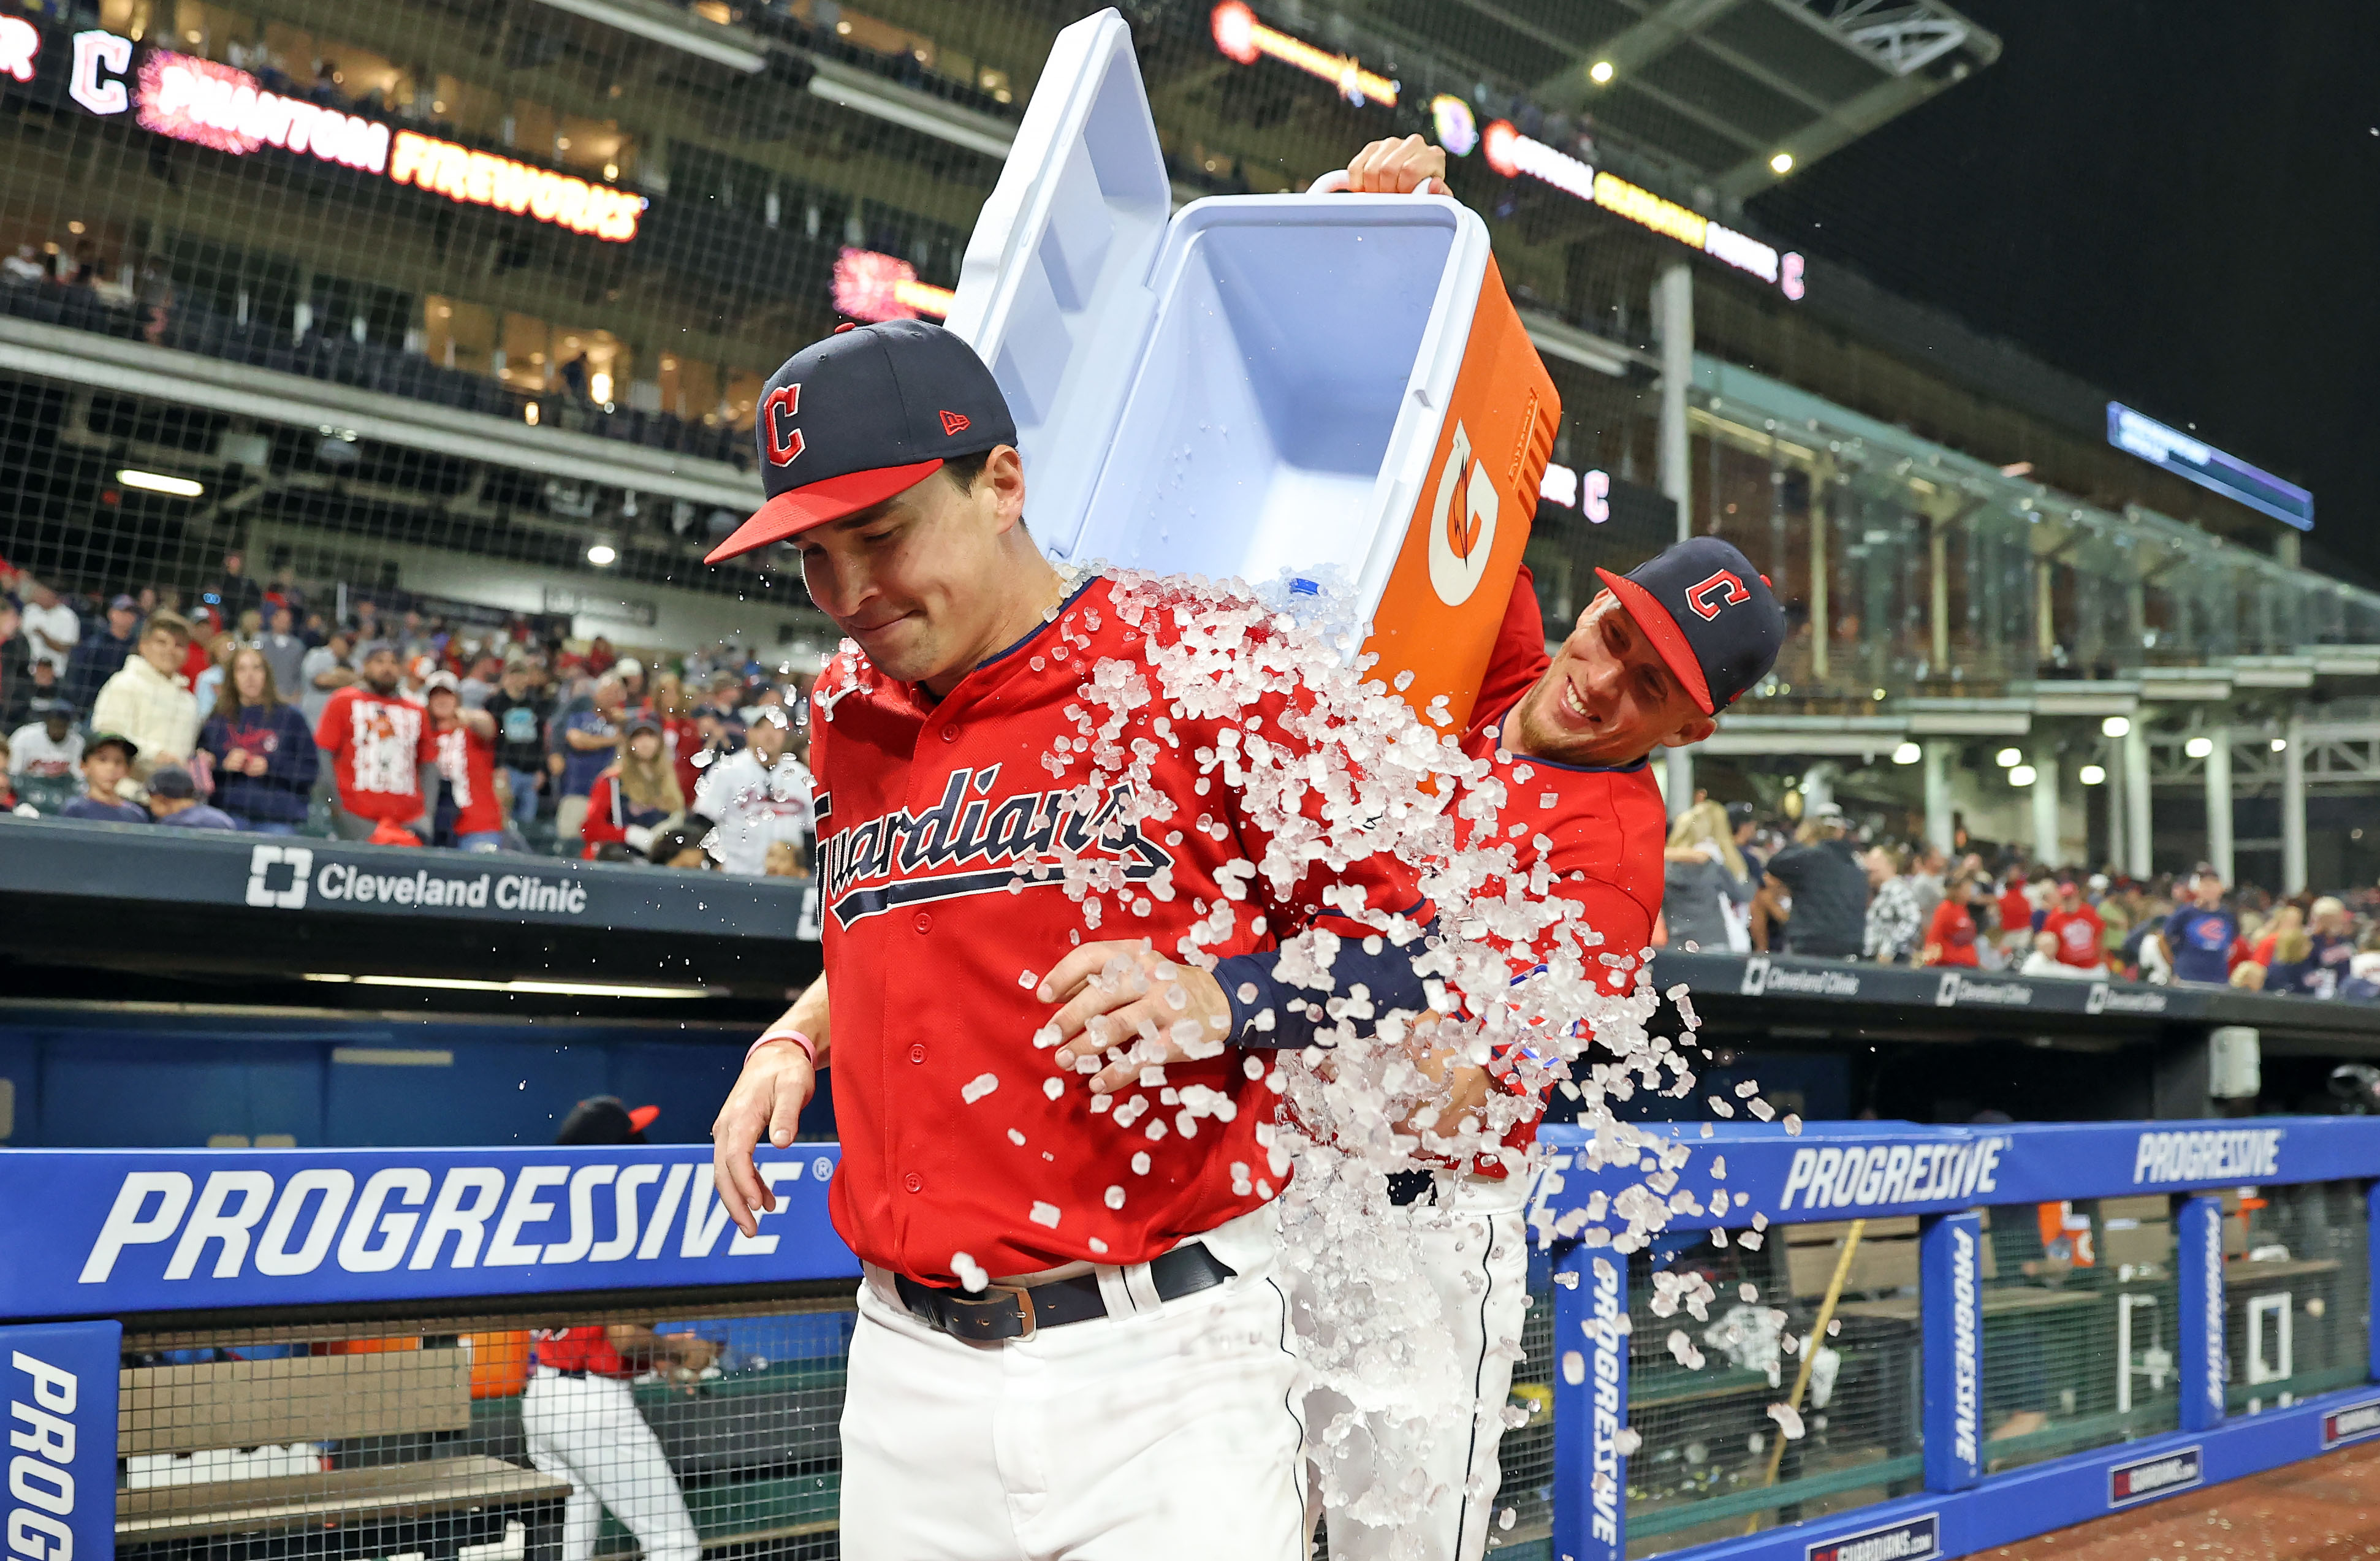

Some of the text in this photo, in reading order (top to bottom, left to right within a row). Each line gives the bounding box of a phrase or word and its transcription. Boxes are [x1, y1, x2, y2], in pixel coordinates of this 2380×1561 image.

[69, 29, 133, 115] C
[390, 129, 645, 243] FIREWORKS
[764, 383, 805, 468] C
[1685, 568, 1751, 621] C
[316, 862, 587, 915] Cleveland Clinic
[1780, 1138, 1999, 1210] PROGRESSIVE
[78, 1161, 804, 1283] PROGRESSIVE
[1953, 1226, 1977, 1465] PROGRESSIVE
